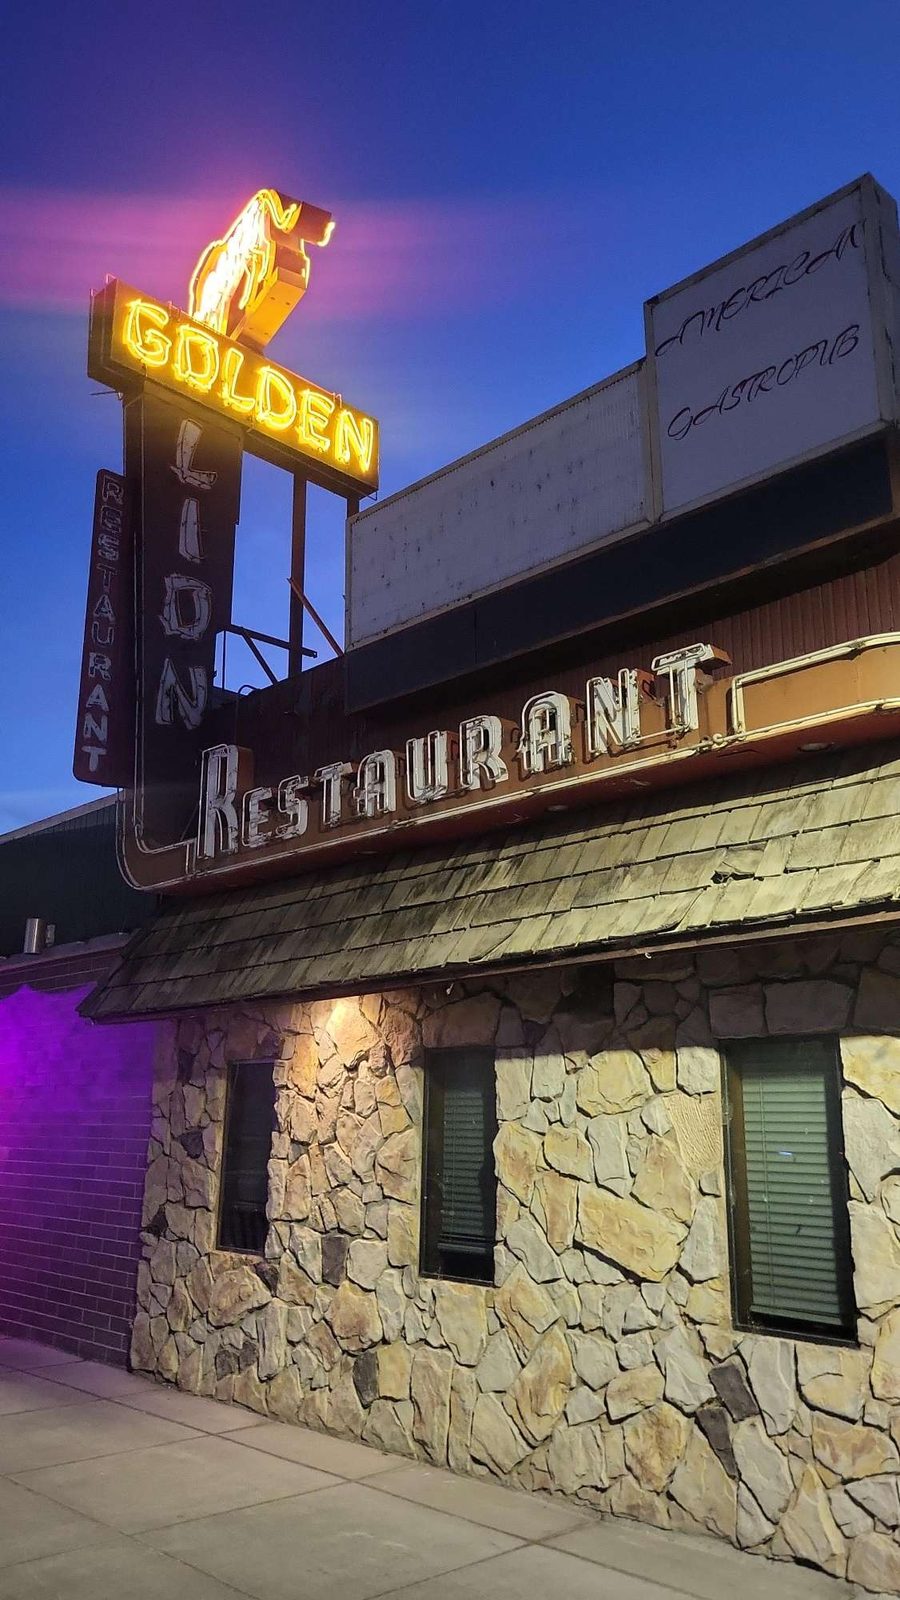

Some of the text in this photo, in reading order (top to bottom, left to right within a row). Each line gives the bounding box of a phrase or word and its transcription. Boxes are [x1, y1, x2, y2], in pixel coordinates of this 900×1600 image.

[121, 298, 374, 473] GOLDEN
[668, 324, 859, 440] GASTROPUB
[83, 475, 124, 774] RESTAURANT
[155, 418, 218, 730] LION
[197, 642, 715, 860] RESTAURANT
